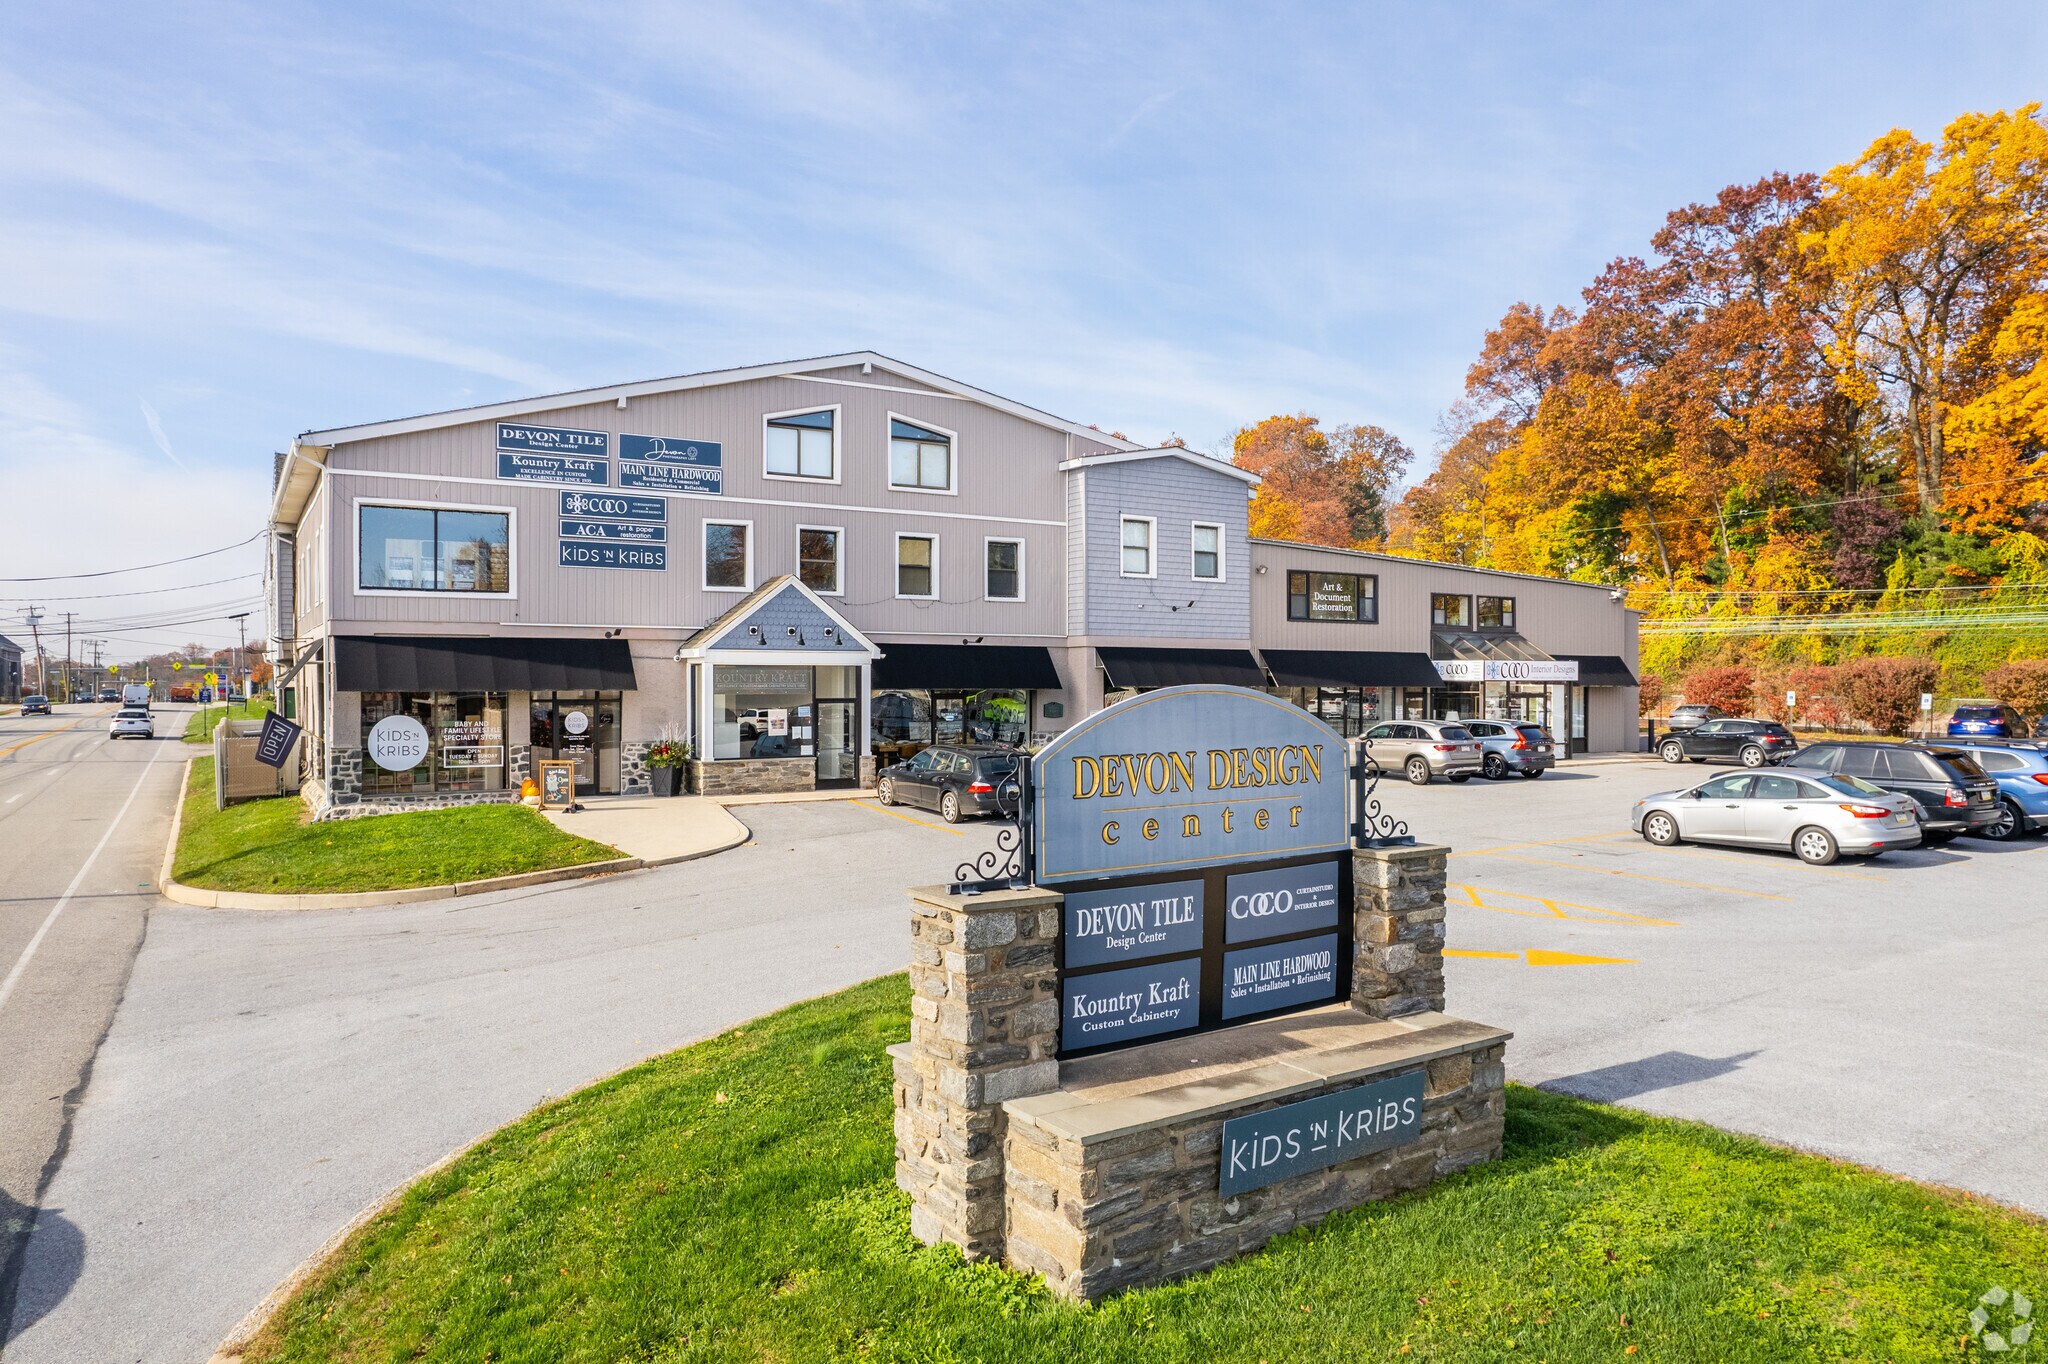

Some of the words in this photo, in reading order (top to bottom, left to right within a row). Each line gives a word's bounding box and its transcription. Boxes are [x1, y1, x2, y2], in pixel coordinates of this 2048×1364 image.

[502, 429, 560, 442] DEVON
[567, 434, 604, 446] TILE
[644, 438, 687, 460] Devon
[512, 455, 560, 471] Kountry
[564, 459, 595, 470] Kraft
[622, 464, 646, 475] MAIN
[649, 466, 669, 477] LINE
[671, 468, 720, 481] HARDWOOD
[589, 498, 628, 514] COCO
[576, 524, 606, 536] ACA
[1323, 582, 1335, 591] Art
[1336, 583, 1343, 591] &
[1314, 592, 1351, 601] Document
[1312, 602, 1352, 611] Restoration
[715, 673, 768, 682] KOUNTRY
[772, 673, 807, 682] KRAFT
[1446, 664, 1468, 675] COCO
[1500, 662, 1529, 679] COCO
[1531, 665, 1552, 673] Interior
[1554, 665, 1575, 675] Designs
[263, 725, 286, 756] OPEN
[1072, 751, 1197, 800] DEVON
[1207, 744, 1323, 790] DESIGN
[1102, 804, 1302, 844] center
[1296, 884, 1334, 895] CURTAINSTUDIO
[1231, 890, 1293, 919] COCO
[1294, 901, 1318, 910] INTERIOR
[1318, 899, 1335, 907] DESIGN
[1076, 902, 1145, 937] DEVON
[1152, 896, 1194, 927] TILE
[1106, 936, 1135, 950] Design
[1138, 932, 1166, 943] Center
[1234, 964, 1257, 986] MAIN
[1260, 960, 1280, 981] LINE
[1283, 950, 1330, 976] HARDWOOD
[1231, 987, 1247, 998] Sales
[1254, 979, 1290, 993] Installation
[1297, 970, 1331, 985] Refinishing
[1072, 992, 1143, 1018] Kountry
[1148, 977, 1190, 1005] Kraft
[1082, 1018, 1124, 1032] Custom
[1129, 1008, 1180, 1024] Cabinetry
